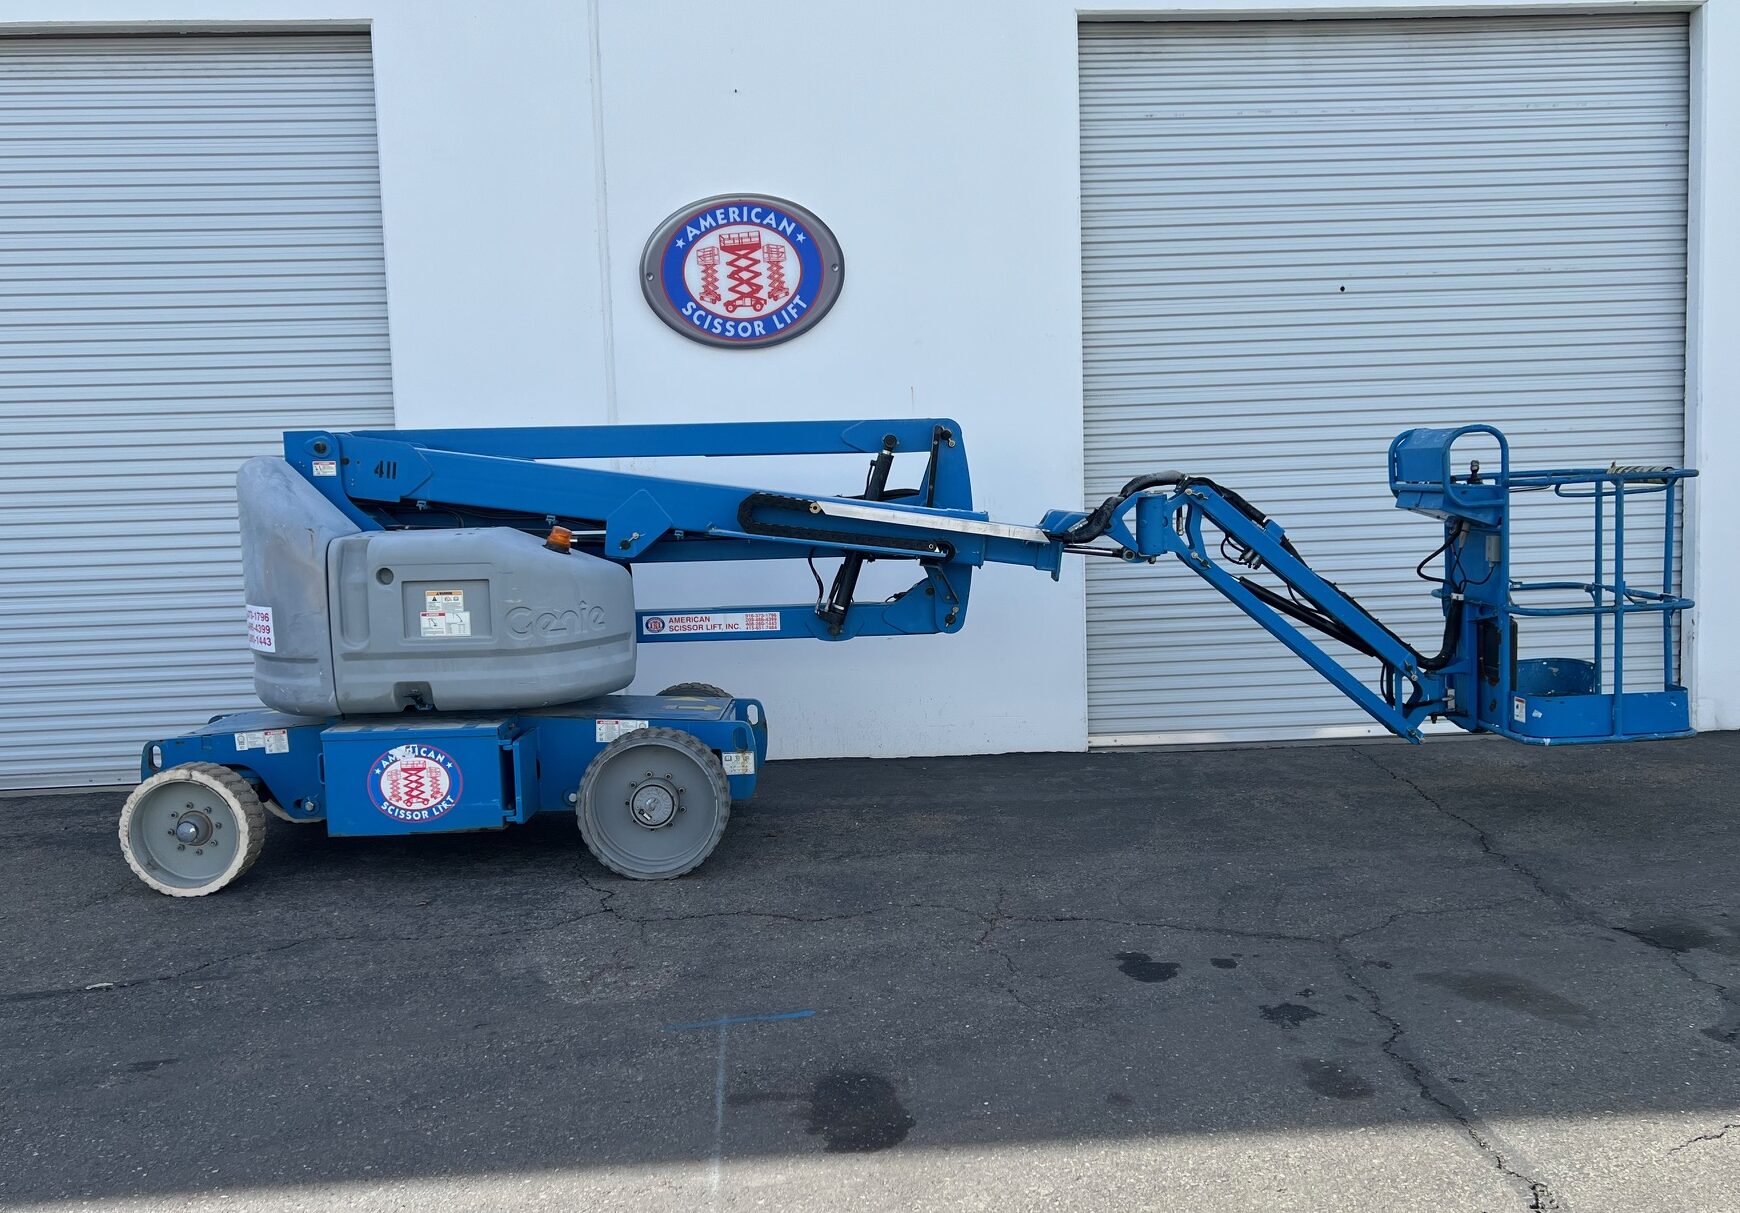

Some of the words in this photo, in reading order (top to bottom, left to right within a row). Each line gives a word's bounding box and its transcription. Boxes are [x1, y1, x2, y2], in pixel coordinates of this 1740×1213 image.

[685, 206, 796, 242] AMERICAN
[681, 301, 766, 338] SCISSOR
[773, 295, 807, 329] LIFT
[668, 616, 711, 624] AMERICAN
[668, 624, 704, 632] SCISSOR
[706, 623, 724, 632] LIFT,
[381, 801, 429, 820] SCISSOR
[432, 795, 454, 816] LIFT
